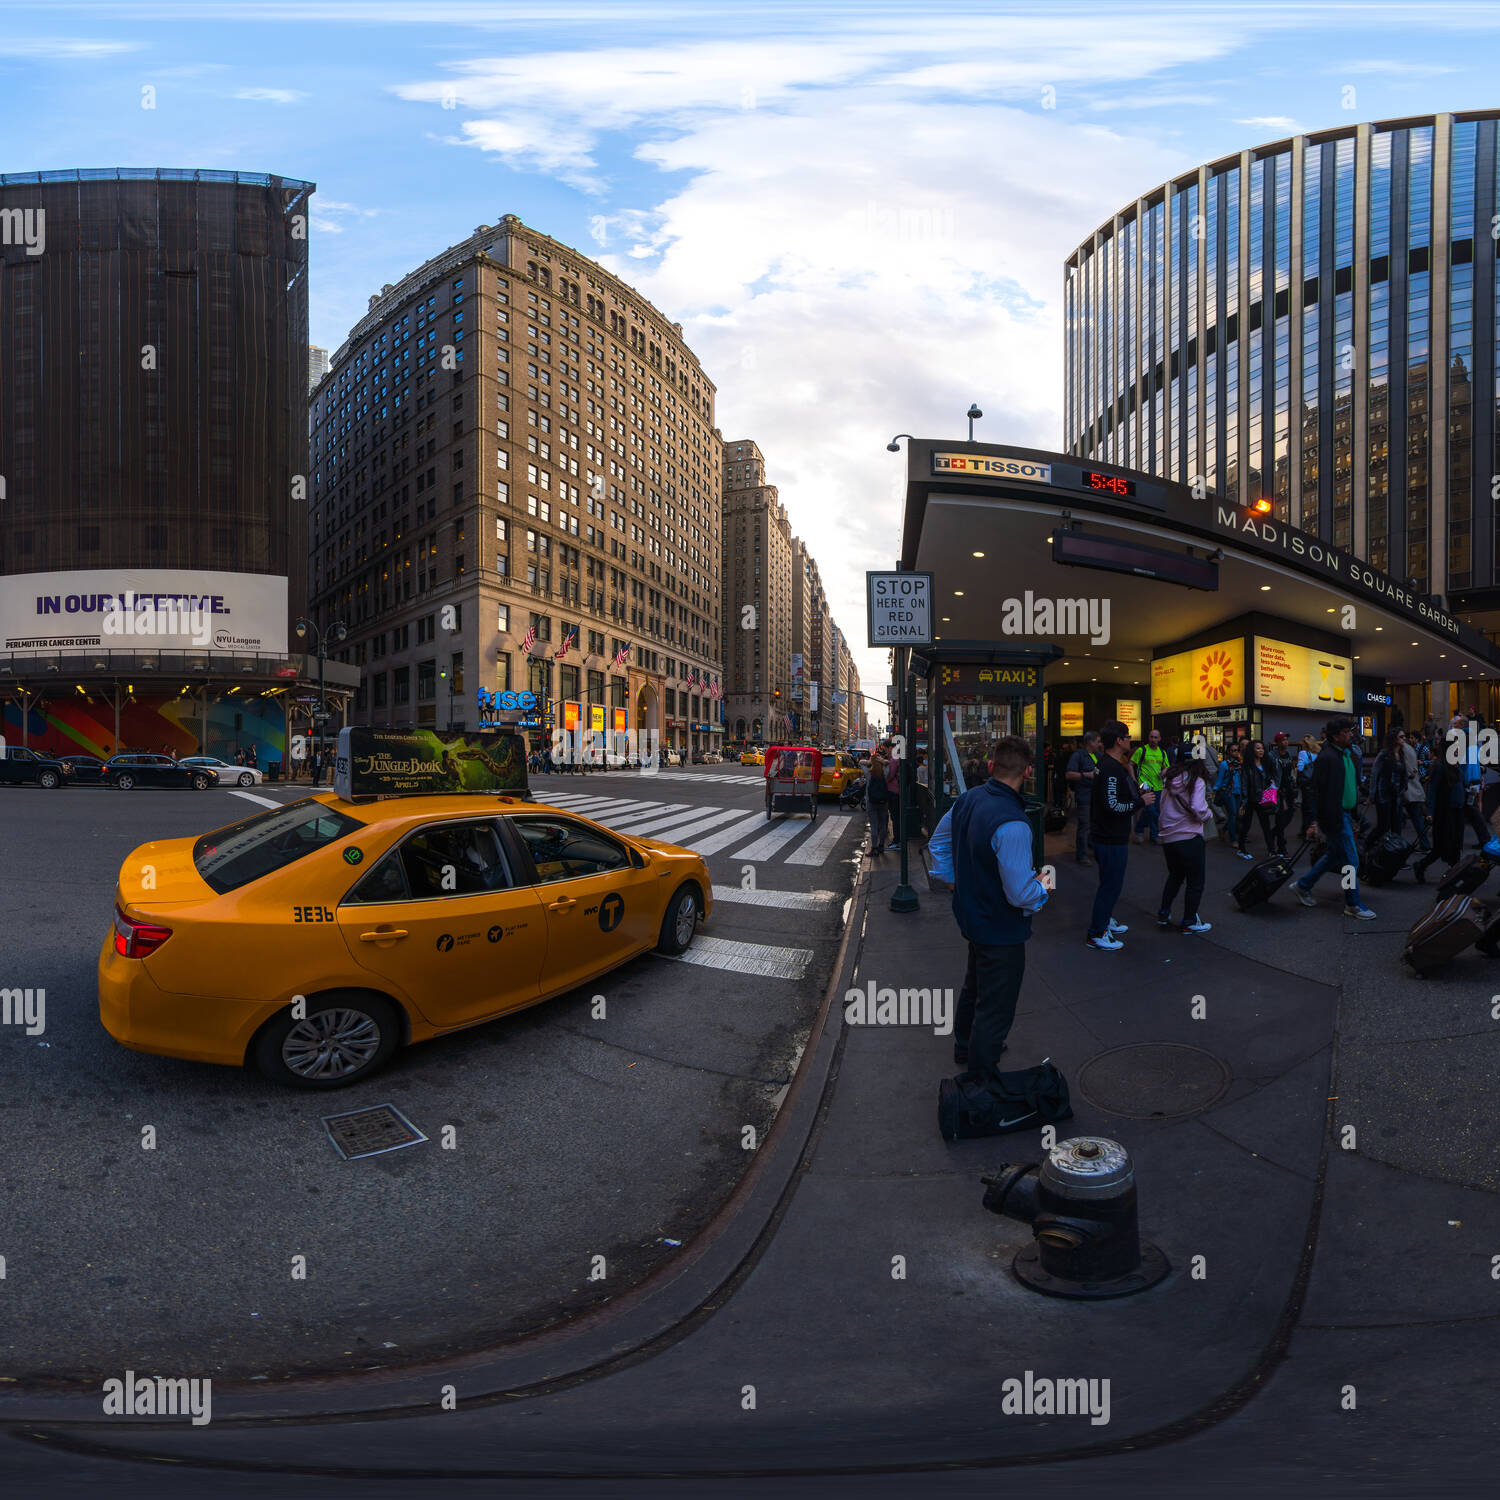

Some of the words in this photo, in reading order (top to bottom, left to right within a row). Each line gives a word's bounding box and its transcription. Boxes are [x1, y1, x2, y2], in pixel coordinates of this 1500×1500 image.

[968, 459, 1050, 479] TISSOT
[1090, 473, 1128, 495] 5:45
[1217, 506, 1340, 571] MADISON
[1350, 564, 1414, 609] SQUARE
[1418, 602, 1460, 634] GARDEN
[876, 580, 925, 595] STOP
[36, 596, 61, 614] IN
[65, 594, 114, 613] OUR
[119, 594, 231, 614] LIFETIME.
[876, 598, 904, 608] HERE
[910, 598, 925, 608] ON
[888, 611, 913, 622] RED
[878, 625, 925, 636] SIGNAL
[5, 640, 47, 648] PERLMUTTER
[49, 638, 74, 647] CANCER
[216, 635, 231, 643] NYU
[233, 636, 261, 645] Langone
[1261, 645, 1272, 653] More
[993, 670, 1025, 682] TAXI
[477, 686, 537, 710] fuse
[1367, 693, 1386, 703] CHASE
[377, 752, 392, 760] THE
[360, 756, 409, 775] JUNGLE
[408, 758, 447, 775] BOOK
[584, 906, 598, 917] NYC
